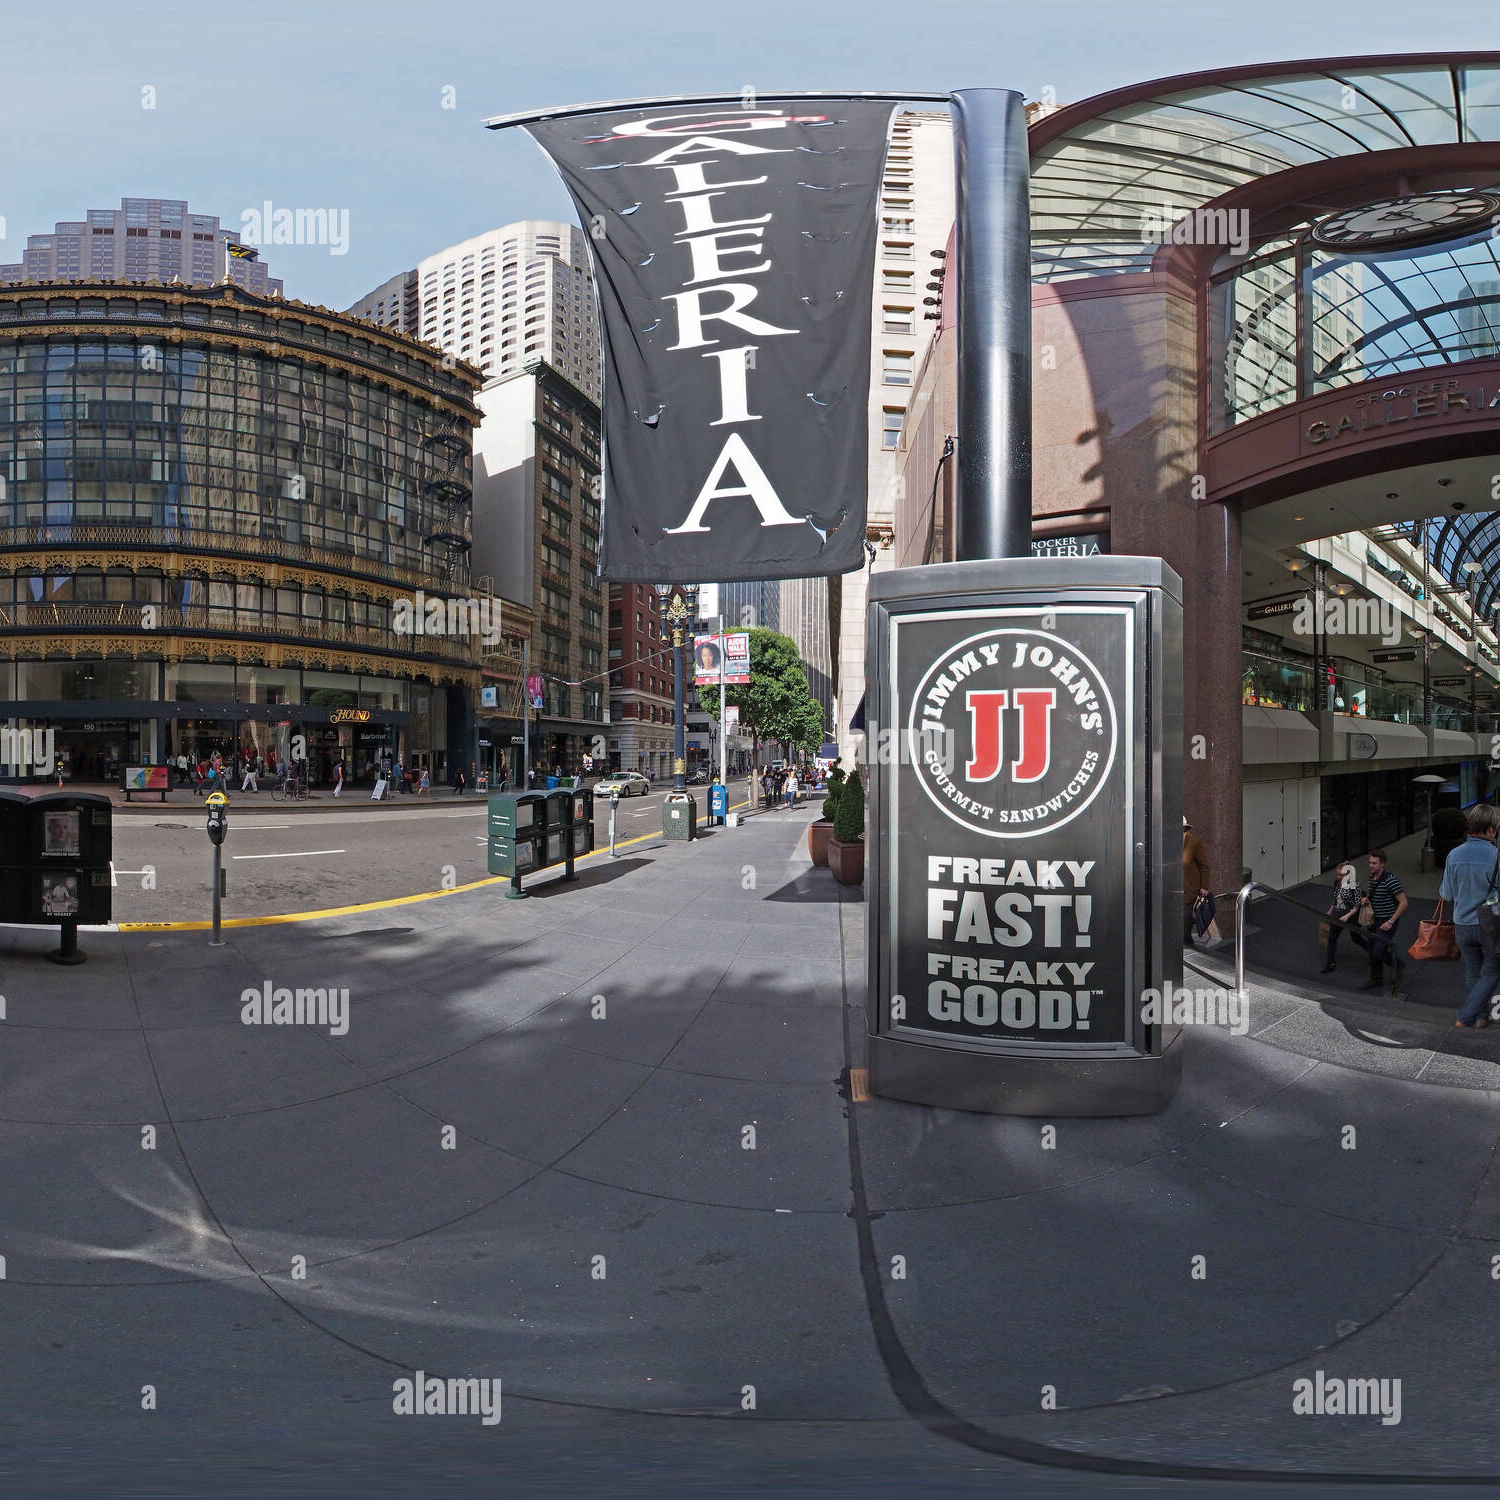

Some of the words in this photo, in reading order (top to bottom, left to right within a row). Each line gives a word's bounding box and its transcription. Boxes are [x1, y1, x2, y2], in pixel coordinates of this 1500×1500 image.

[611, 109, 807, 534] GALLERIA
[1355, 379, 1460, 409] CROCKER
[1031, 537, 1077, 550] ROCKER
[922, 642, 1000, 733] JIMMY
[330, 708, 371, 723] HOUND
[965, 687, 1057, 783] JJ
[925, 749, 993, 820] GOURMET
[999, 750, 1100, 824] SANDWICHES
[928, 855, 1096, 888] FREAKY
[927, 888, 1092, 948] FAST!
[927, 952, 1095, 986] FREAKY
